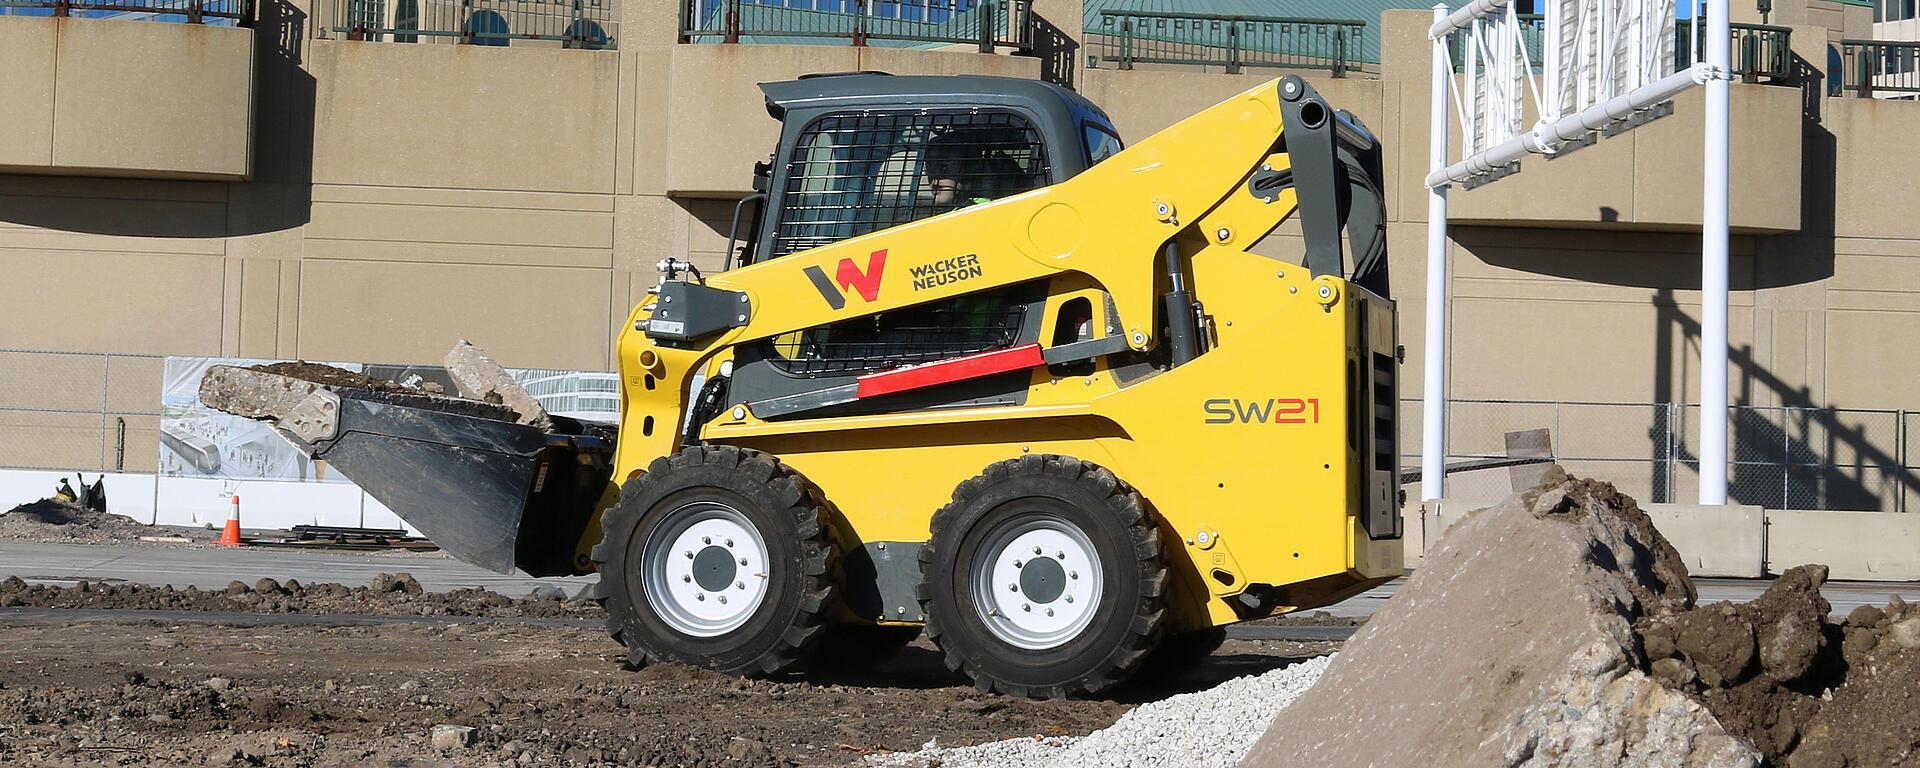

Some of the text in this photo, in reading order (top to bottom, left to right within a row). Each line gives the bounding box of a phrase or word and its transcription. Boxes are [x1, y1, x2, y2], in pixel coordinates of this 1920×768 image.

[909, 253, 980, 279] WACKER
[913, 265, 982, 292] NEUSON
[1203, 398, 1319, 424] SW21
